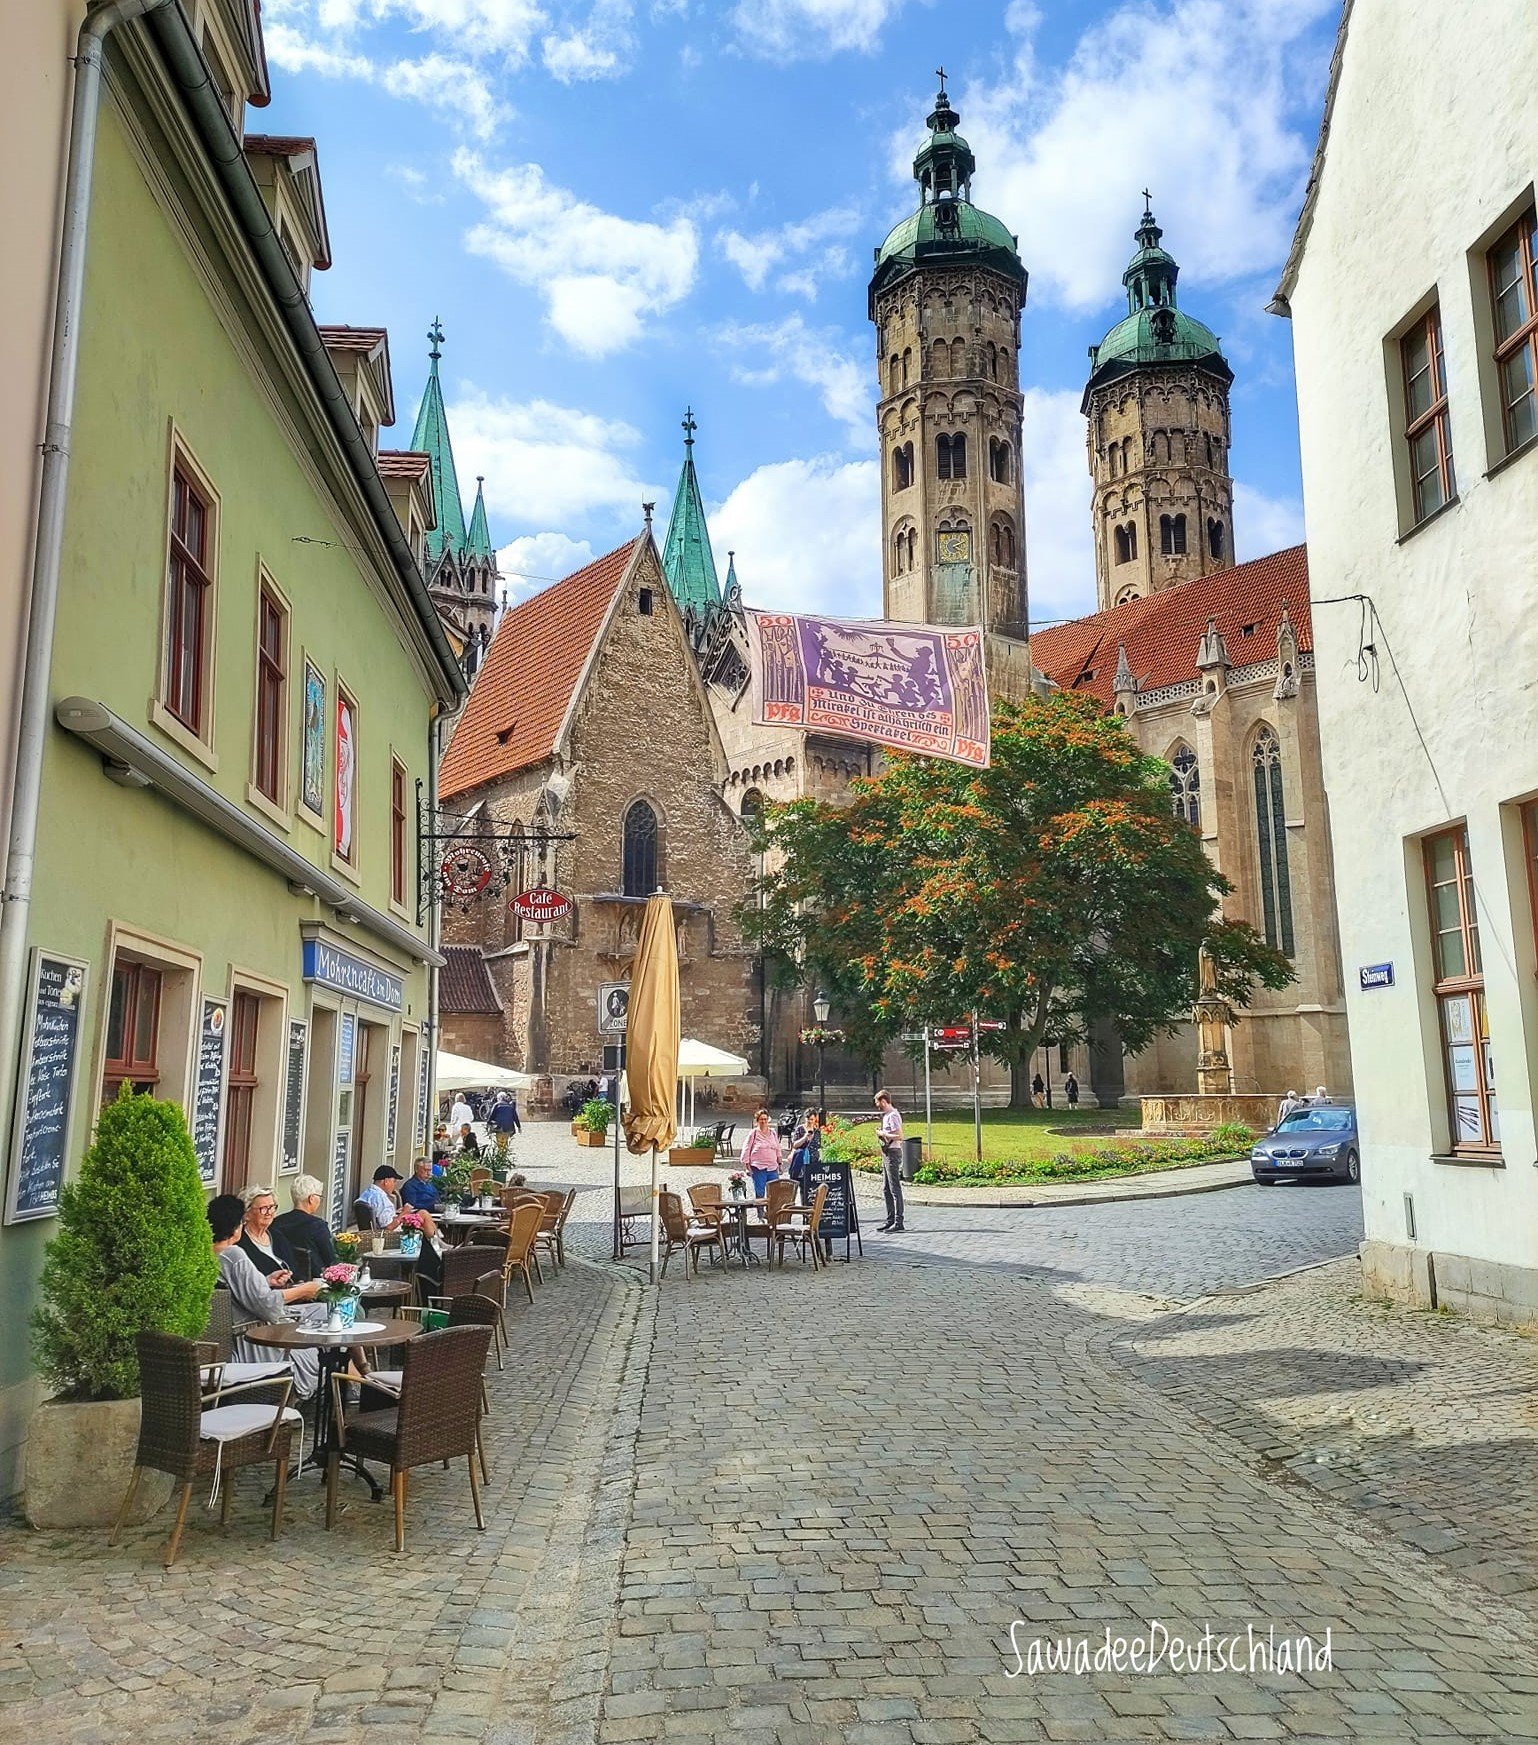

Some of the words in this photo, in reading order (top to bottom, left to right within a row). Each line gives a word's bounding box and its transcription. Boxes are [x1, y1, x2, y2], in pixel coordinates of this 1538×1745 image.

[811, 698, 860, 716] Mirakel
[514, 901, 569, 919] Restaurant
[810, 1173, 842, 1182] HEIMBS
